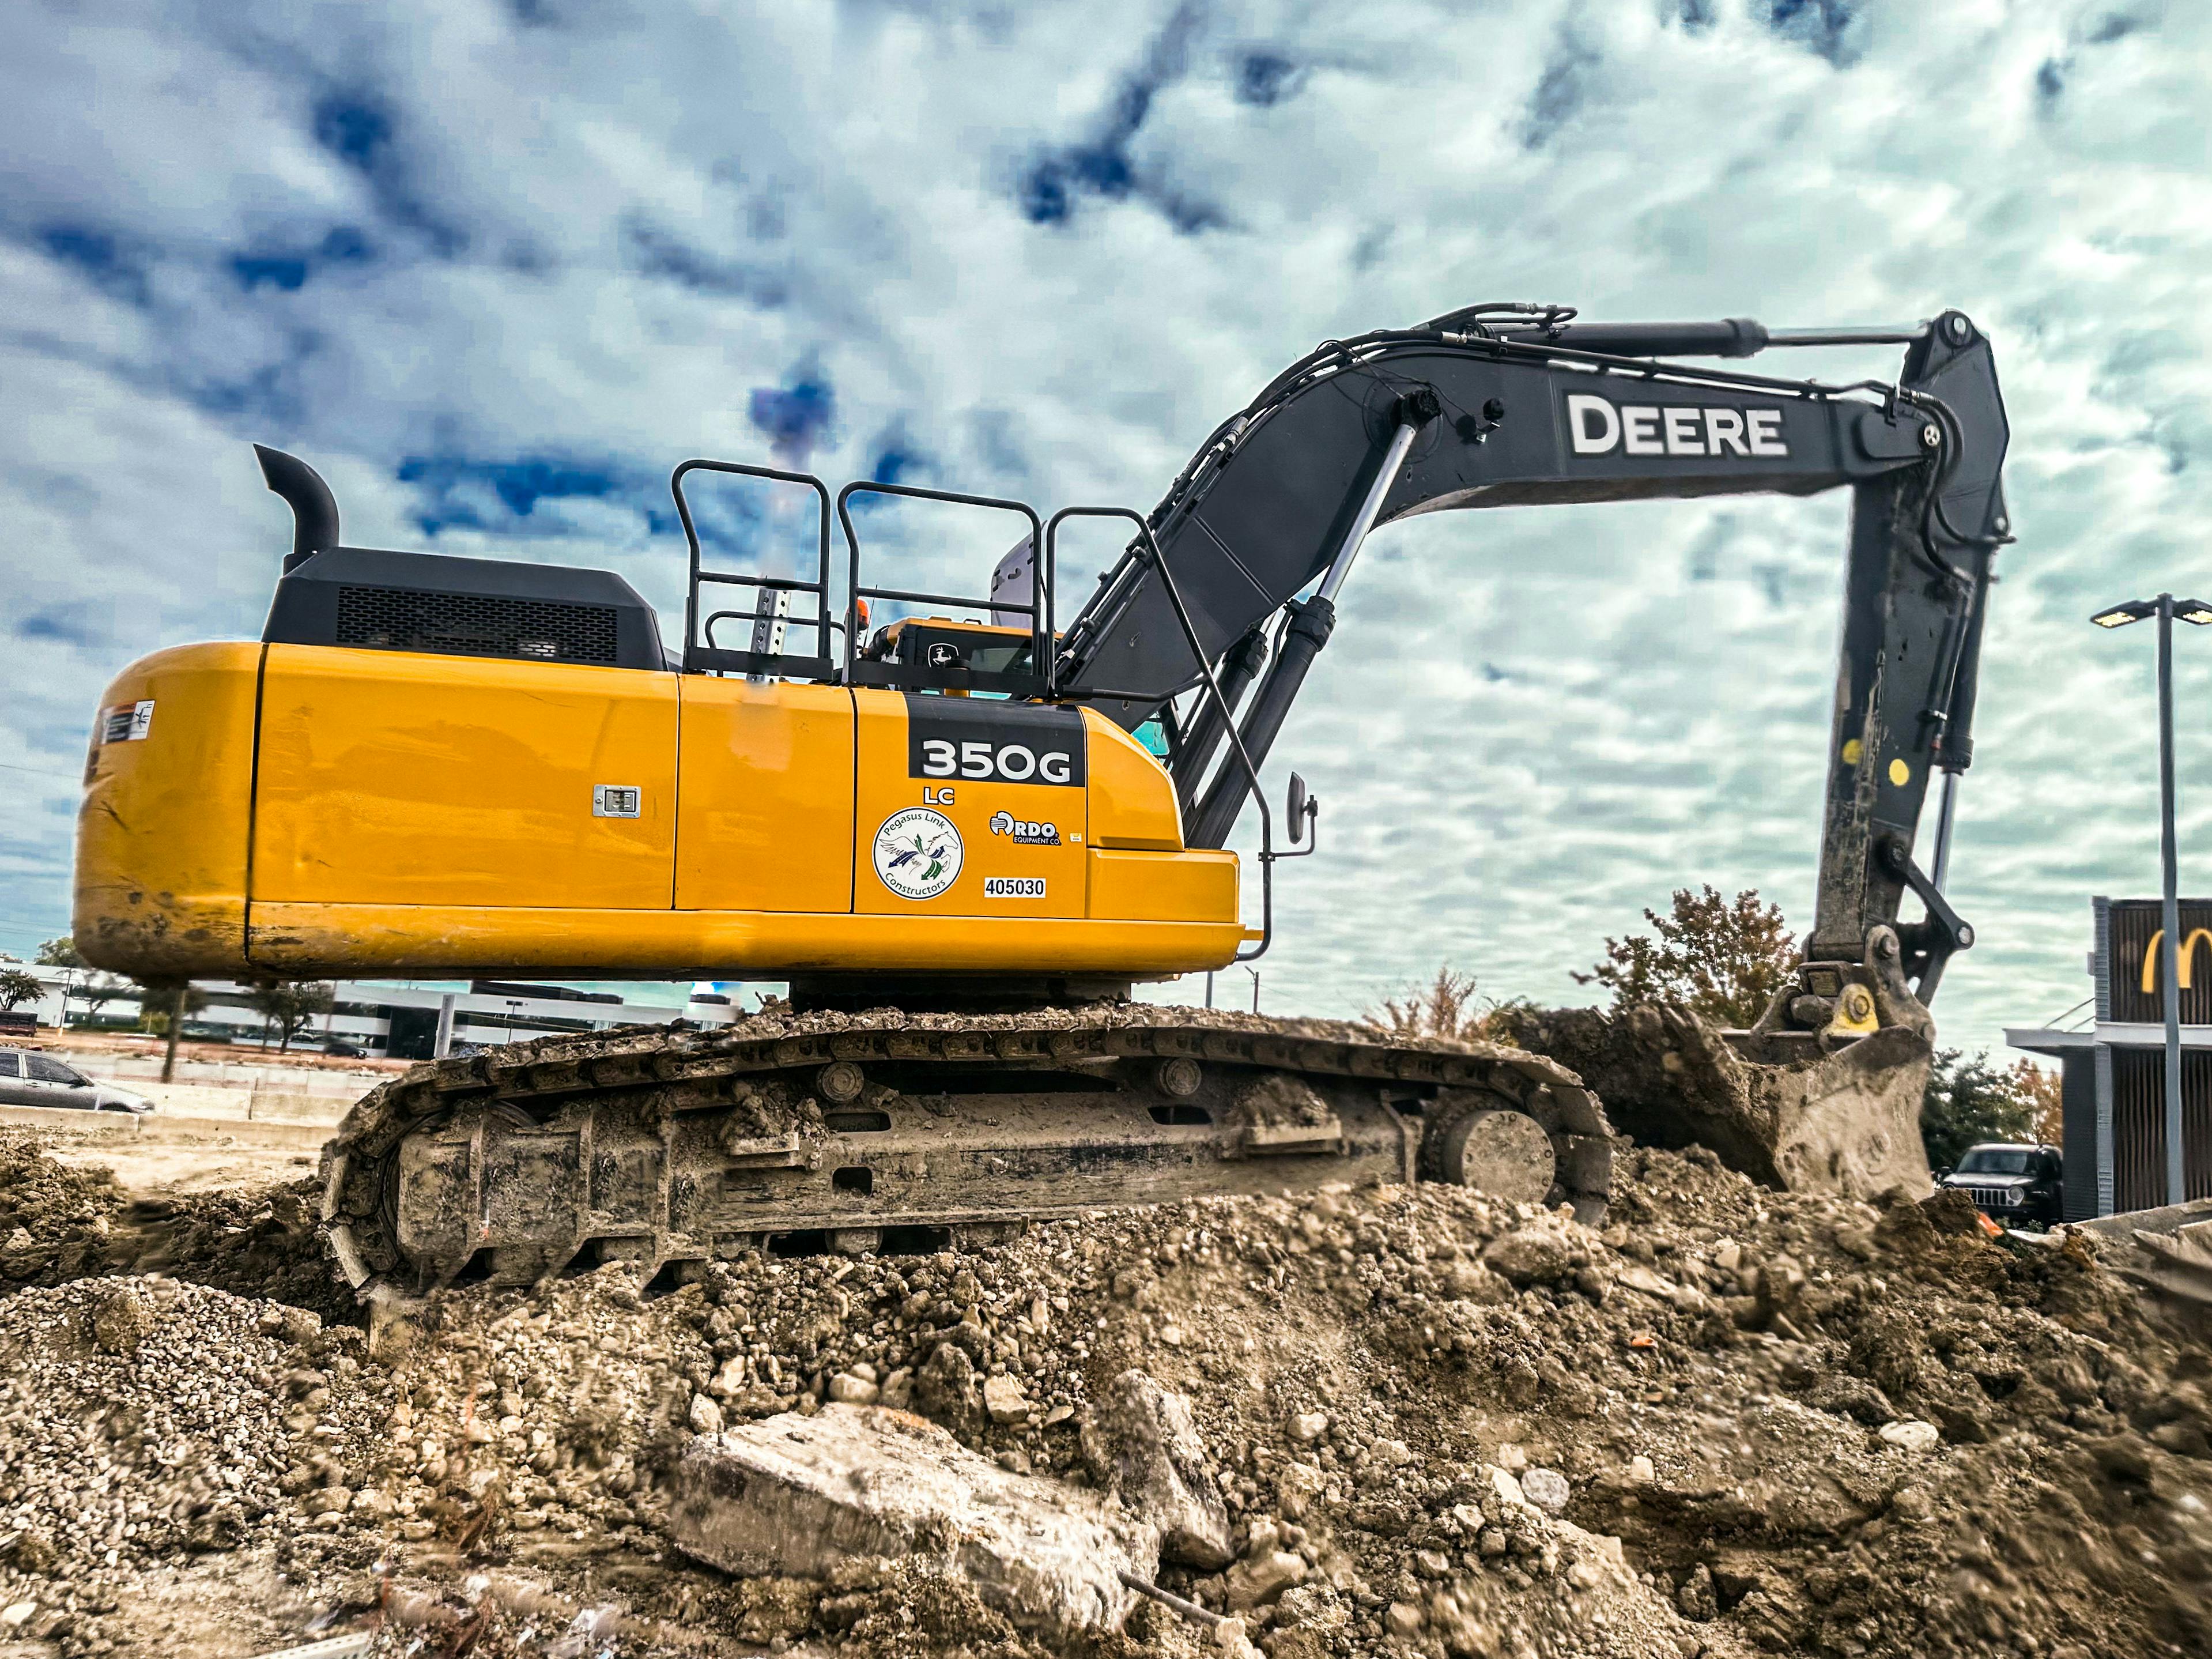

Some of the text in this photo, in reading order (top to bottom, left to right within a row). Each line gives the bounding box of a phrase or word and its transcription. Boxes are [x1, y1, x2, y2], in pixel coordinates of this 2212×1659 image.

[1568, 394, 1788, 455] DEERE
[923, 740, 1070, 783] 350G
[924, 787, 954, 804] LC
[884, 813, 945, 836] Pegasus Link
[885, 873, 946, 895] Constructors
[986, 880, 1044, 895] 405030
